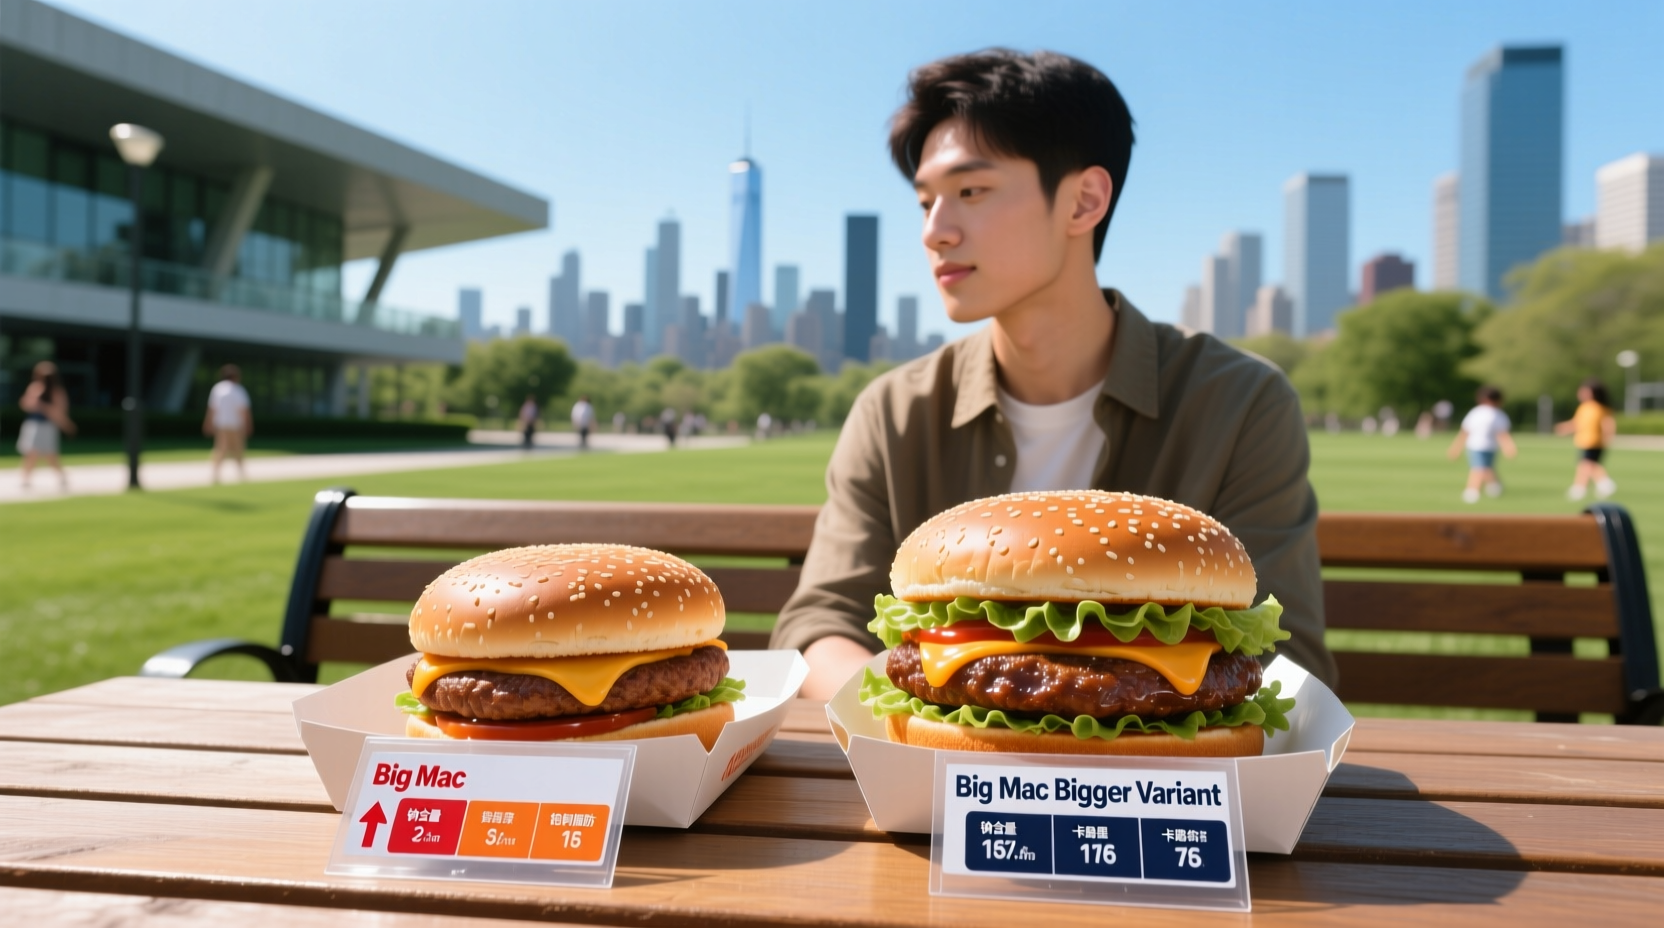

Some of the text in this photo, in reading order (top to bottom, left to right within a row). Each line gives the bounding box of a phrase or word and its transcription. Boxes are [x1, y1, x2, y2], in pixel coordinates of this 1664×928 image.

[372, 762, 467, 792] Big Mac
[955, 774, 1222, 809] Big Mac Bigger Variant
[1080, 843, 1117, 864] 176
